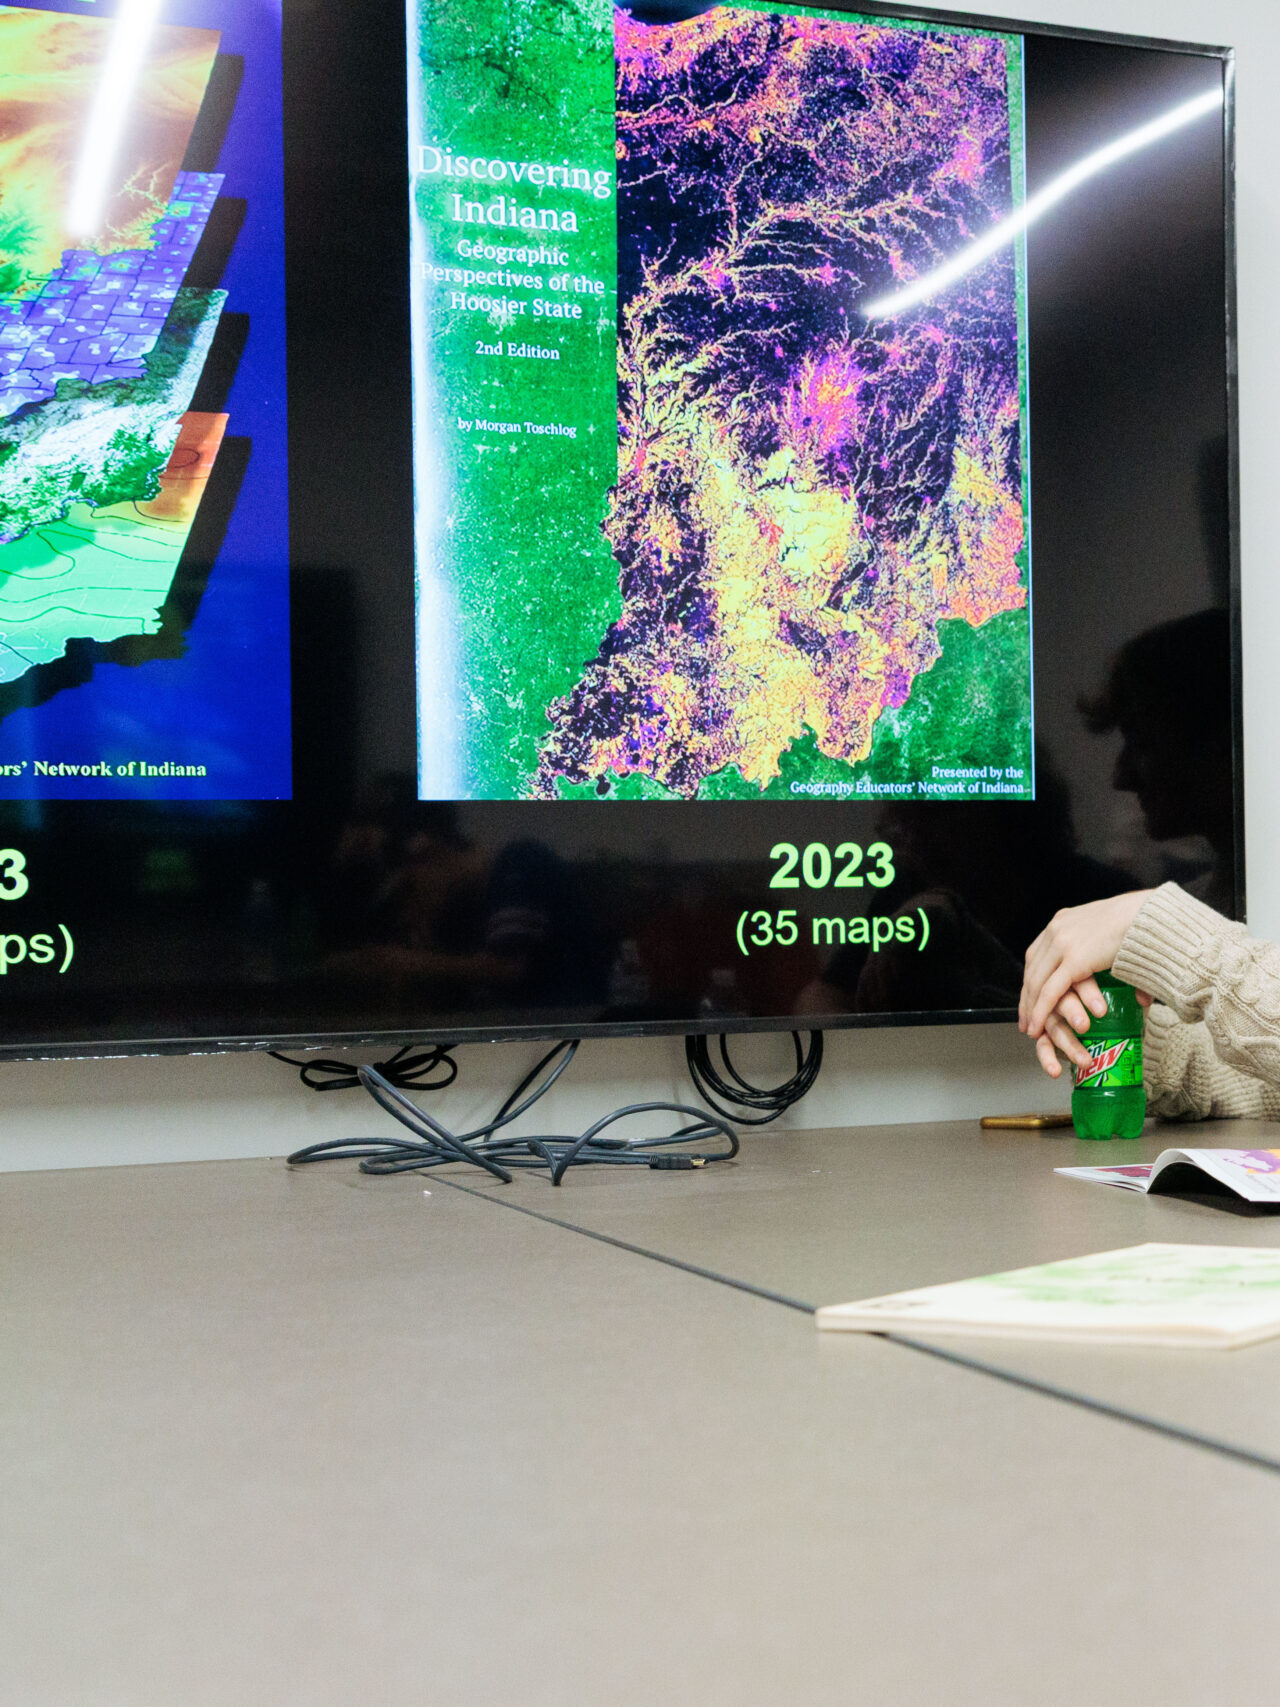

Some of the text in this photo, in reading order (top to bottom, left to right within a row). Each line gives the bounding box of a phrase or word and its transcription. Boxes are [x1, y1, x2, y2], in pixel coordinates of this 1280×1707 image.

[416, 145, 612, 199] Discovering
[451, 193, 579, 232] Indiana
[457, 239, 569, 267] Geographic
[421, 262, 605, 295] Perspectives of the
[450, 292, 583, 319] Hoosier State
[475, 340, 560, 360] 2nd Edition
[457, 416, 577, 439] by Morgan Toschlog
[33, 761, 113, 777] Network
[117, 761, 137, 777] of
[140, 761, 207, 777] Indiana
[932, 765, 1024, 781] Presented by the
[790, 781, 853, 796] Geography
[918, 781, 966, 794] Network
[968, 781, 980, 794] of
[982, 781, 1024, 794] Indiana
[0, 848, 29, 901] 3
[769, 841, 896, 889] 2023
[736, 907, 930, 956] (35 maps)
[0, 924, 74, 975] ps)
